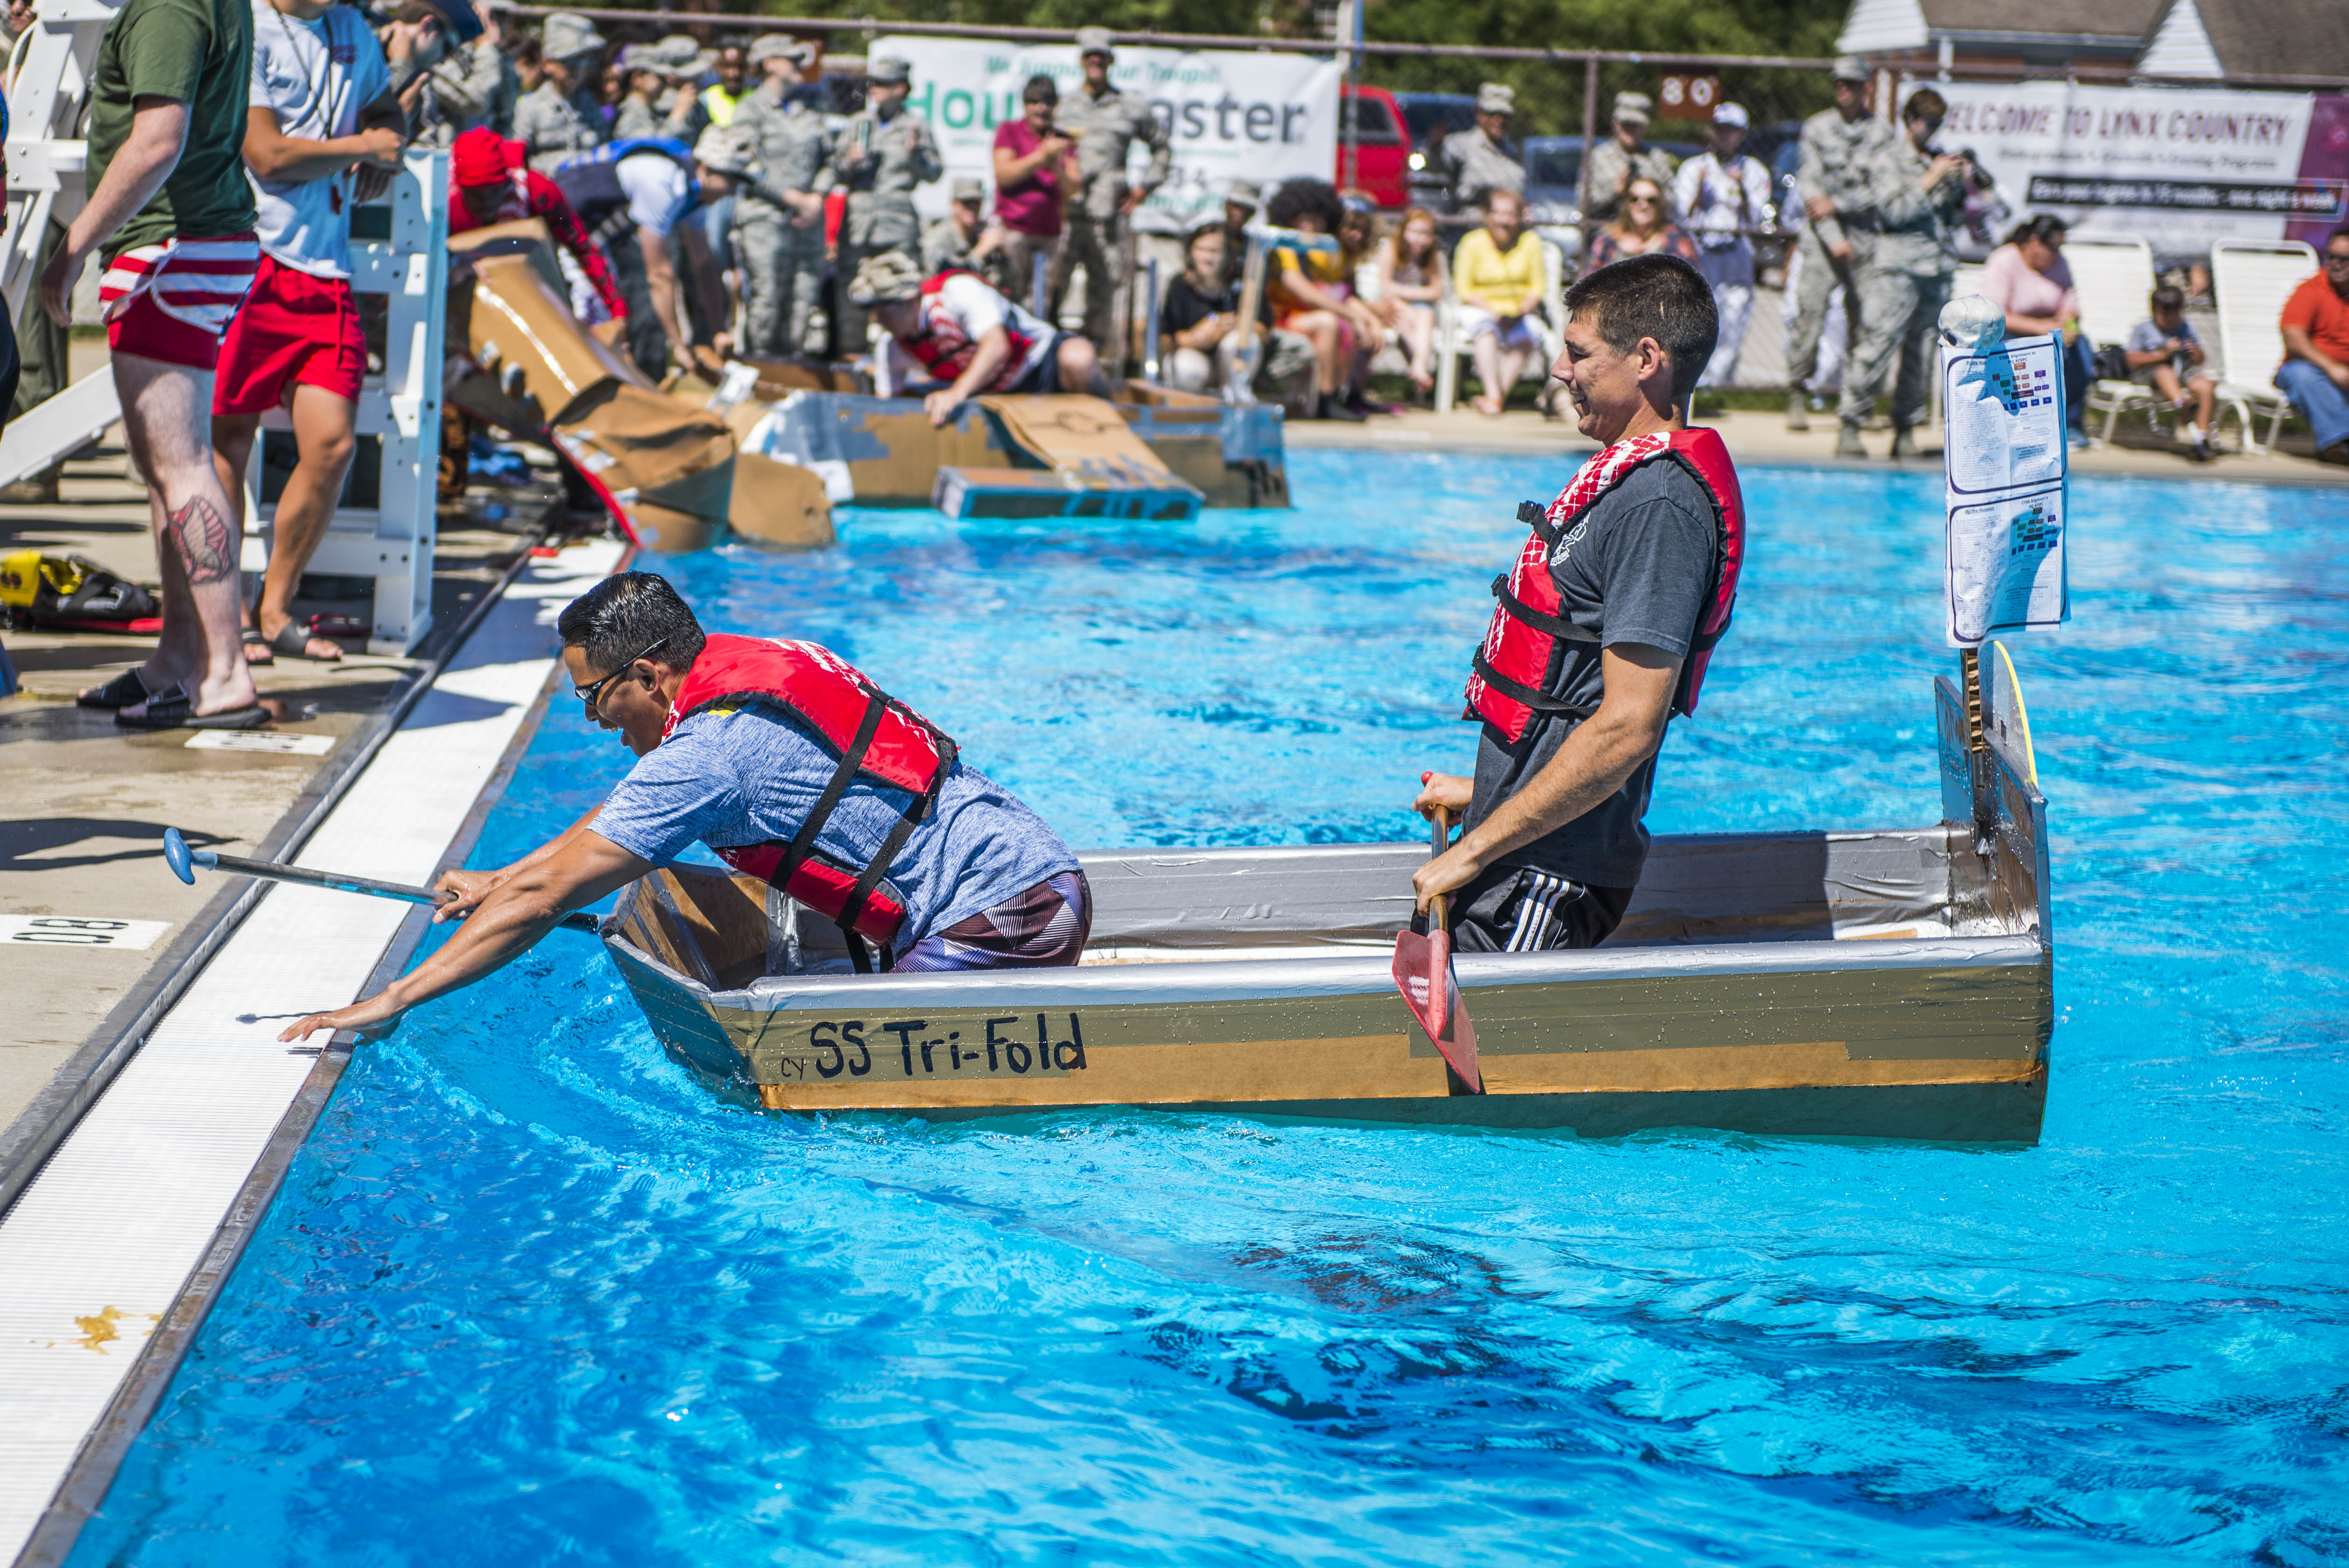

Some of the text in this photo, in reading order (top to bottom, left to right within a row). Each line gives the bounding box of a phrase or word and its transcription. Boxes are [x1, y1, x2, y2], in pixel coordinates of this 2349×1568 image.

[1945, 101, 2054, 137] ELCOME
[2168, 109, 2292, 146] COUNTRY
[810, 1020, 871, 1079] SS
[883, 1012, 1089, 1076] Tri-Fold
